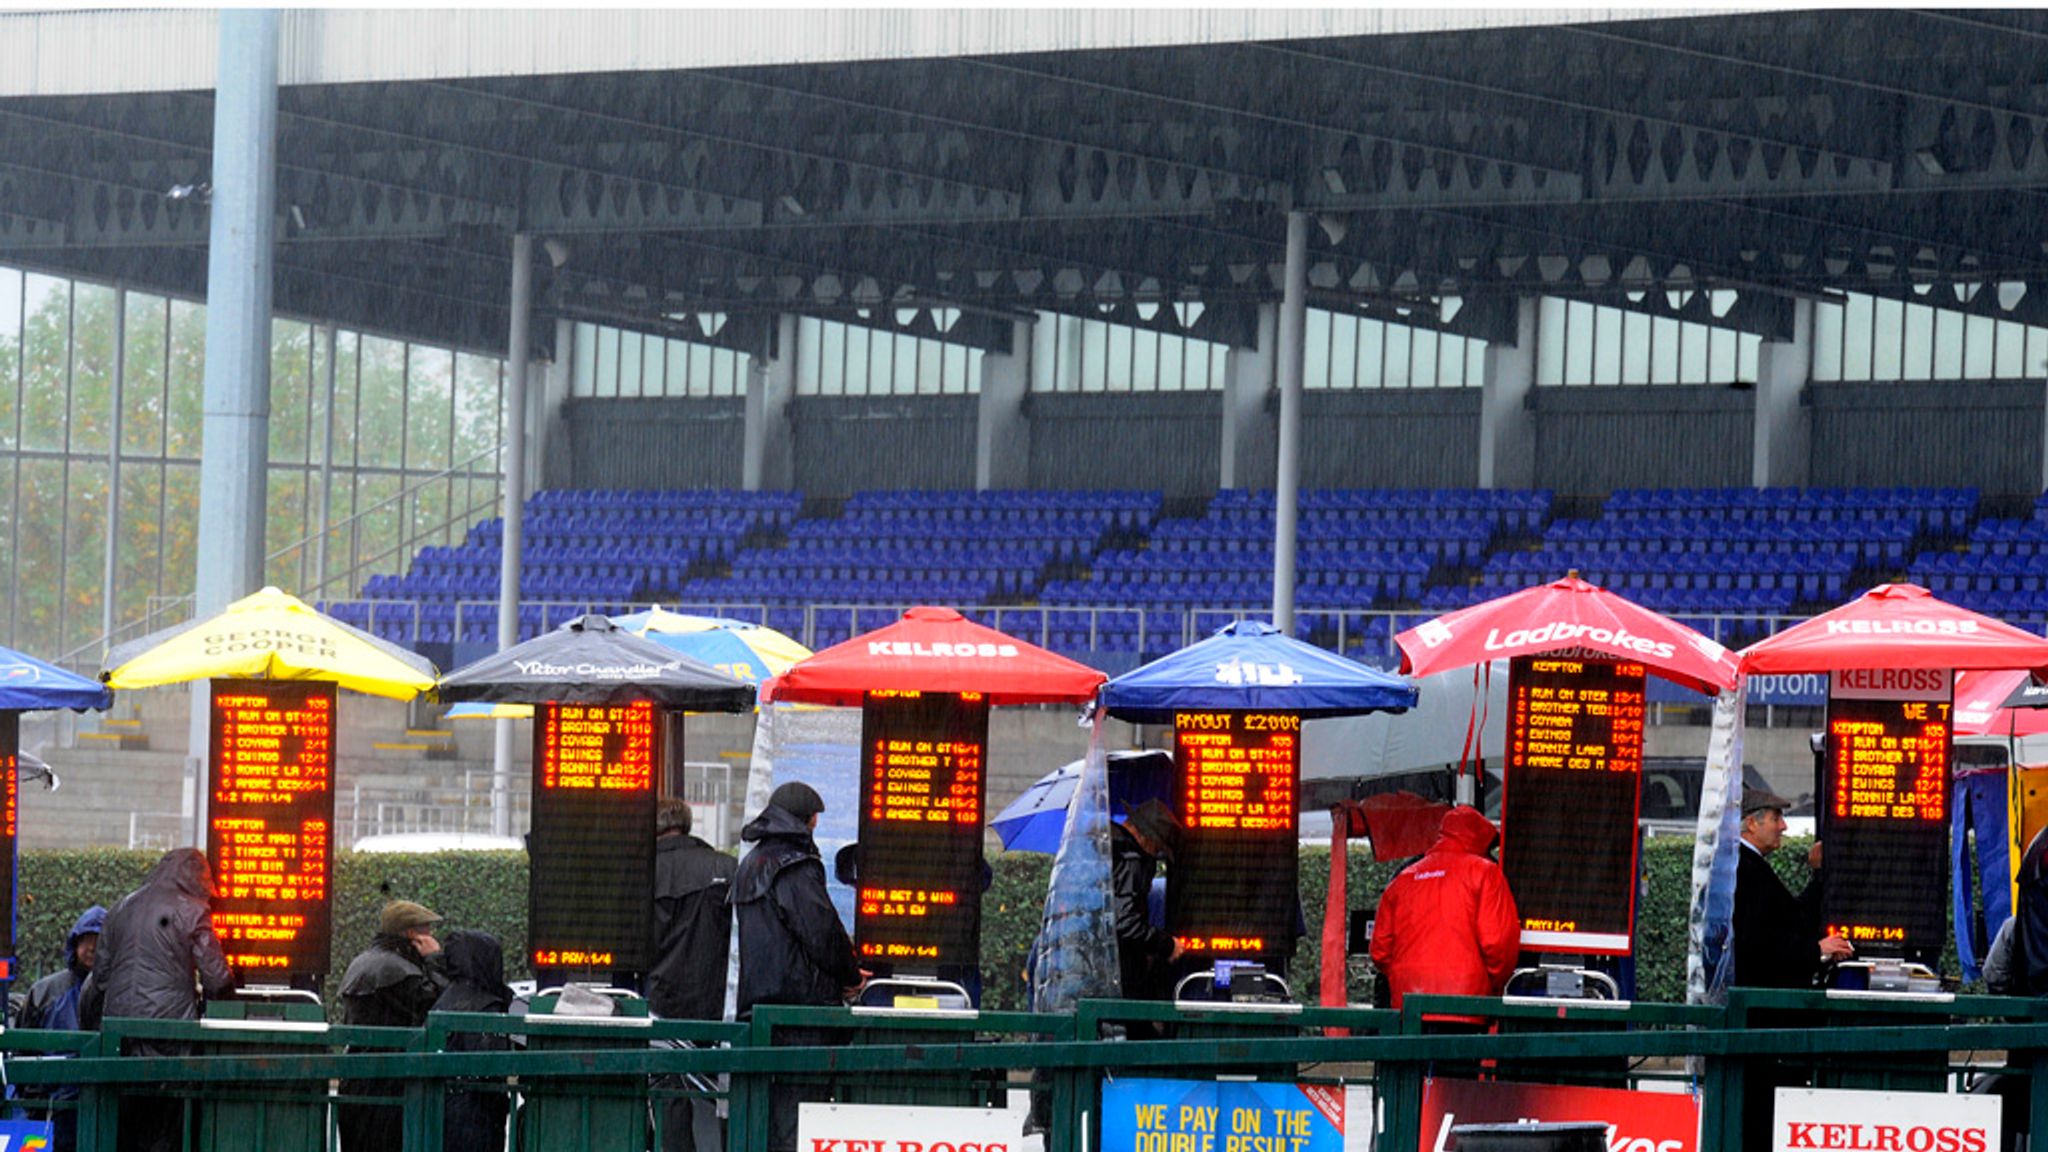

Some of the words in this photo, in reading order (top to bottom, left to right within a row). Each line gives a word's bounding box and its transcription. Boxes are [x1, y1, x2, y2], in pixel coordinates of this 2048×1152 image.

[1827, 620, 1979, 634] KELROSS
[204, 629, 336, 647] GEORGE
[1484, 622, 1676, 658] Ladbrokes
[205, 640, 336, 659] COOPER
[868, 642, 1018, 657] KELROSS
[576, 661, 670, 677] Chandler
[1532, 661, 1583, 673] KEMPTON
[1840, 668, 1942, 691] KELROSS
[217, 695, 268, 708] KEMPTON
[1903, 703, 1928, 720] WE
[1832, 721, 1884, 735] KEMPTON
[1180, 734, 1232, 746] KEMPTON
[1852, 750, 1903, 763] BROTHER
[1851, 790, 1894, 804] RONNIE
[213, 818, 265, 831] KEMPTON
[234, 833, 264, 844] BUCK
[1135, 1104, 1167, 1130] WE
[1180, 1106, 1220, 1132] PAY
[1232, 1107, 1261, 1134] ON
[1274, 1109, 1313, 1137] THE
[1135, 1131, 1214, 1152] DOUBLE
[1786, 1122, 1987, 1152] KELROSS
